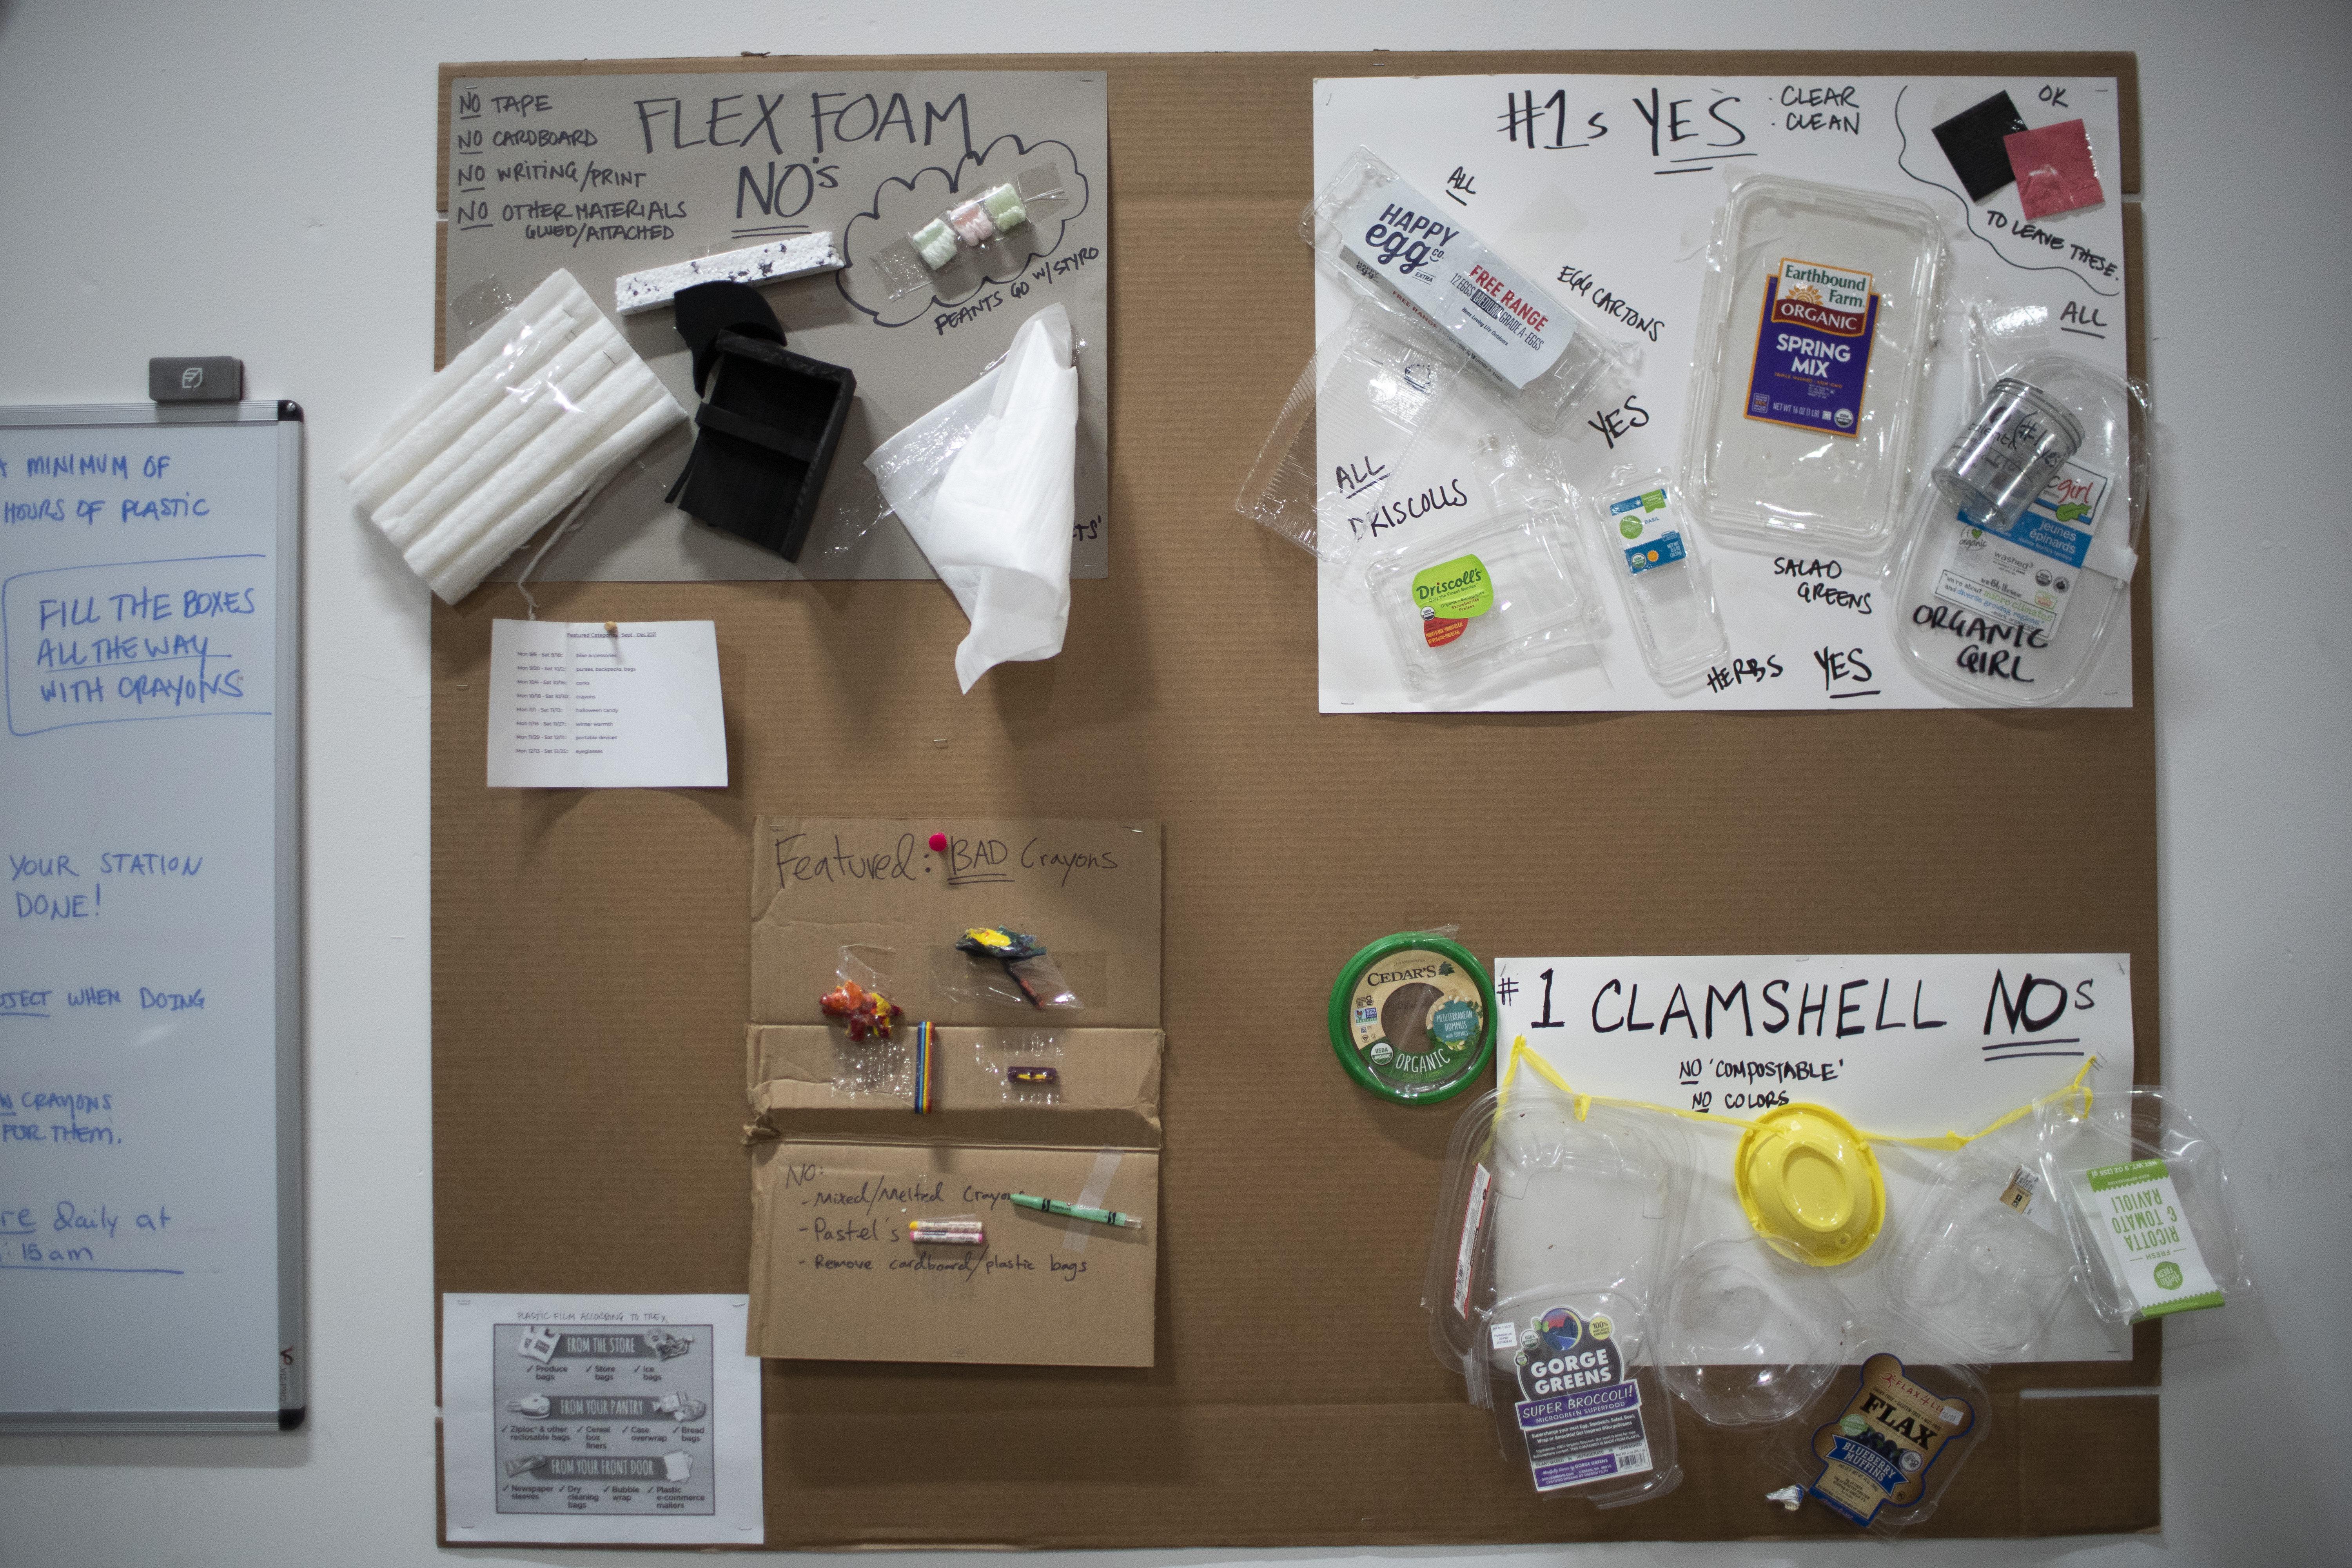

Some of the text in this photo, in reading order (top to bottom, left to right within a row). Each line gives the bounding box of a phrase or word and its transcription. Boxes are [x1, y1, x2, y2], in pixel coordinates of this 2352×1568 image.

[459, 92, 553, 118] NO TAPE
[1780, 86, 1860, 109] CLEAR
[2039, 85, 2068, 107] OK
[634, 93, 977, 160] FLEX FOAM
[1632, 88, 1747, 156] YES
[1786, 112, 1860, 135] CLEAN
[458, 129, 598, 149] NO CARDBOARD
[458, 165, 485, 186] NO
[1447, 166, 1476, 195] ALL
[457, 199, 688, 223] NO OTHER MATERIALS
[526, 225, 675, 249] GLUED/ATTACHED
[1379, 203, 1460, 246] HAPPY
[1365, 223, 1431, 274] egg
[1987, 211, 2119, 281] TO LEAVE THESE.
[1415, 271, 1433, 283] EXTRA
[1785, 265, 1866, 291] Earthbound
[1010, 281, 1030, 300] GO
[1470, 264, 1548, 332] FREE RANGE
[1557, 265, 1664, 342] EGG CARTONS
[1450, 272, 1544, 351] 12 EGGS MEDIUM GRADE EGGS
[1781, 303, 1857, 330] ORGANIC
[2060, 301, 2107, 327] ALL
[1462, 307, 1508, 346] Hens Loving Life Outdoors
[1776, 334, 1851, 362] SPRING
[1791, 357, 1830, 378] MIX
[1588, 395, 1649, 449] YES
[27, 454, 170, 479] MINIMUM OF
[1336, 456, 1386, 493] ALL
[4, 499, 65, 523] HOURS
[76, 501, 106, 524] OF
[2029, 529, 2076, 554] épinards
[2040, 520, 2076, 541] jeunes
[1774, 557, 1842, 578] SALAD
[1416, 568, 1481, 600] Driscoll's
[40, 586, 254, 631] FILL THE BOXES
[1451, 598, 1479, 610] Strawberries
[1798, 582, 1872, 615] GREENS
[1913, 604, 2049, 649] ORGANIC
[37, 634, 209, 676] ALL THE WAY
[1956, 644, 2034, 683] GIRL
[1707, 646, 1872, 693] HERBS YES
[41, 670, 243, 706] WITH CRAYONS
[10, 853, 202, 880] YOUR STATION
[775, 833, 1118, 889] Featured: BAD Crayons
[16, 883, 102, 919] DONE!
[1367, 965, 1437, 986] CEDAR'S
[67, 987, 121, 1007] WHEN
[140, 987, 205, 1010] DOING
[1592, 978, 1946, 1040] CLAMSHELL
[1436, 1011, 1473, 1023] MEDITERRANEAN
[1445, 1023, 1467, 1031] HOMMUS
[1396, 1048, 1450, 1073] ORGANIC
[1680, 1058, 1702, 1079] NO
[22, 1092, 113, 1118] CRAYONS
[1691, 1090, 1790, 1109] NO COLORS
[2, 1122, 122, 1144] FOR THEM.
[2111, 1188, 2163, 1214] RAVIOLI
[136, 1206, 171, 1230] at
[2112, 1205, 2178, 1234] & TOMATO
[2123, 1225, 2180, 1252] RICOTTA
[815, 1245, 1087, 1281] Remove cardboard/plastic bags
[2146, 1250, 2171, 1260] FRESH
[567, 1337, 635, 1353] FROM THE STORE
[1531, 1348, 1609, 1378] GORGE
[1535, 1367, 1612, 1394] GREENS
[1896, 1380, 1920, 1398] FLAX
[561, 1400, 643, 1415] FROM YOUR PANTRY
[1523, 1385, 1633, 1418] SUPER BROCCOLI!
[1536, 1401, 1625, 1424] MICROGREEN SUPERFOOD
[1859, 1392, 1938, 1450] FLAX
[551, 1459, 653, 1475] FROM YOUR FRONT DOOR
[1842, 1442, 1896, 1478] BLUEBERRY
[1844, 1452, 1885, 1481] MUFFINS
